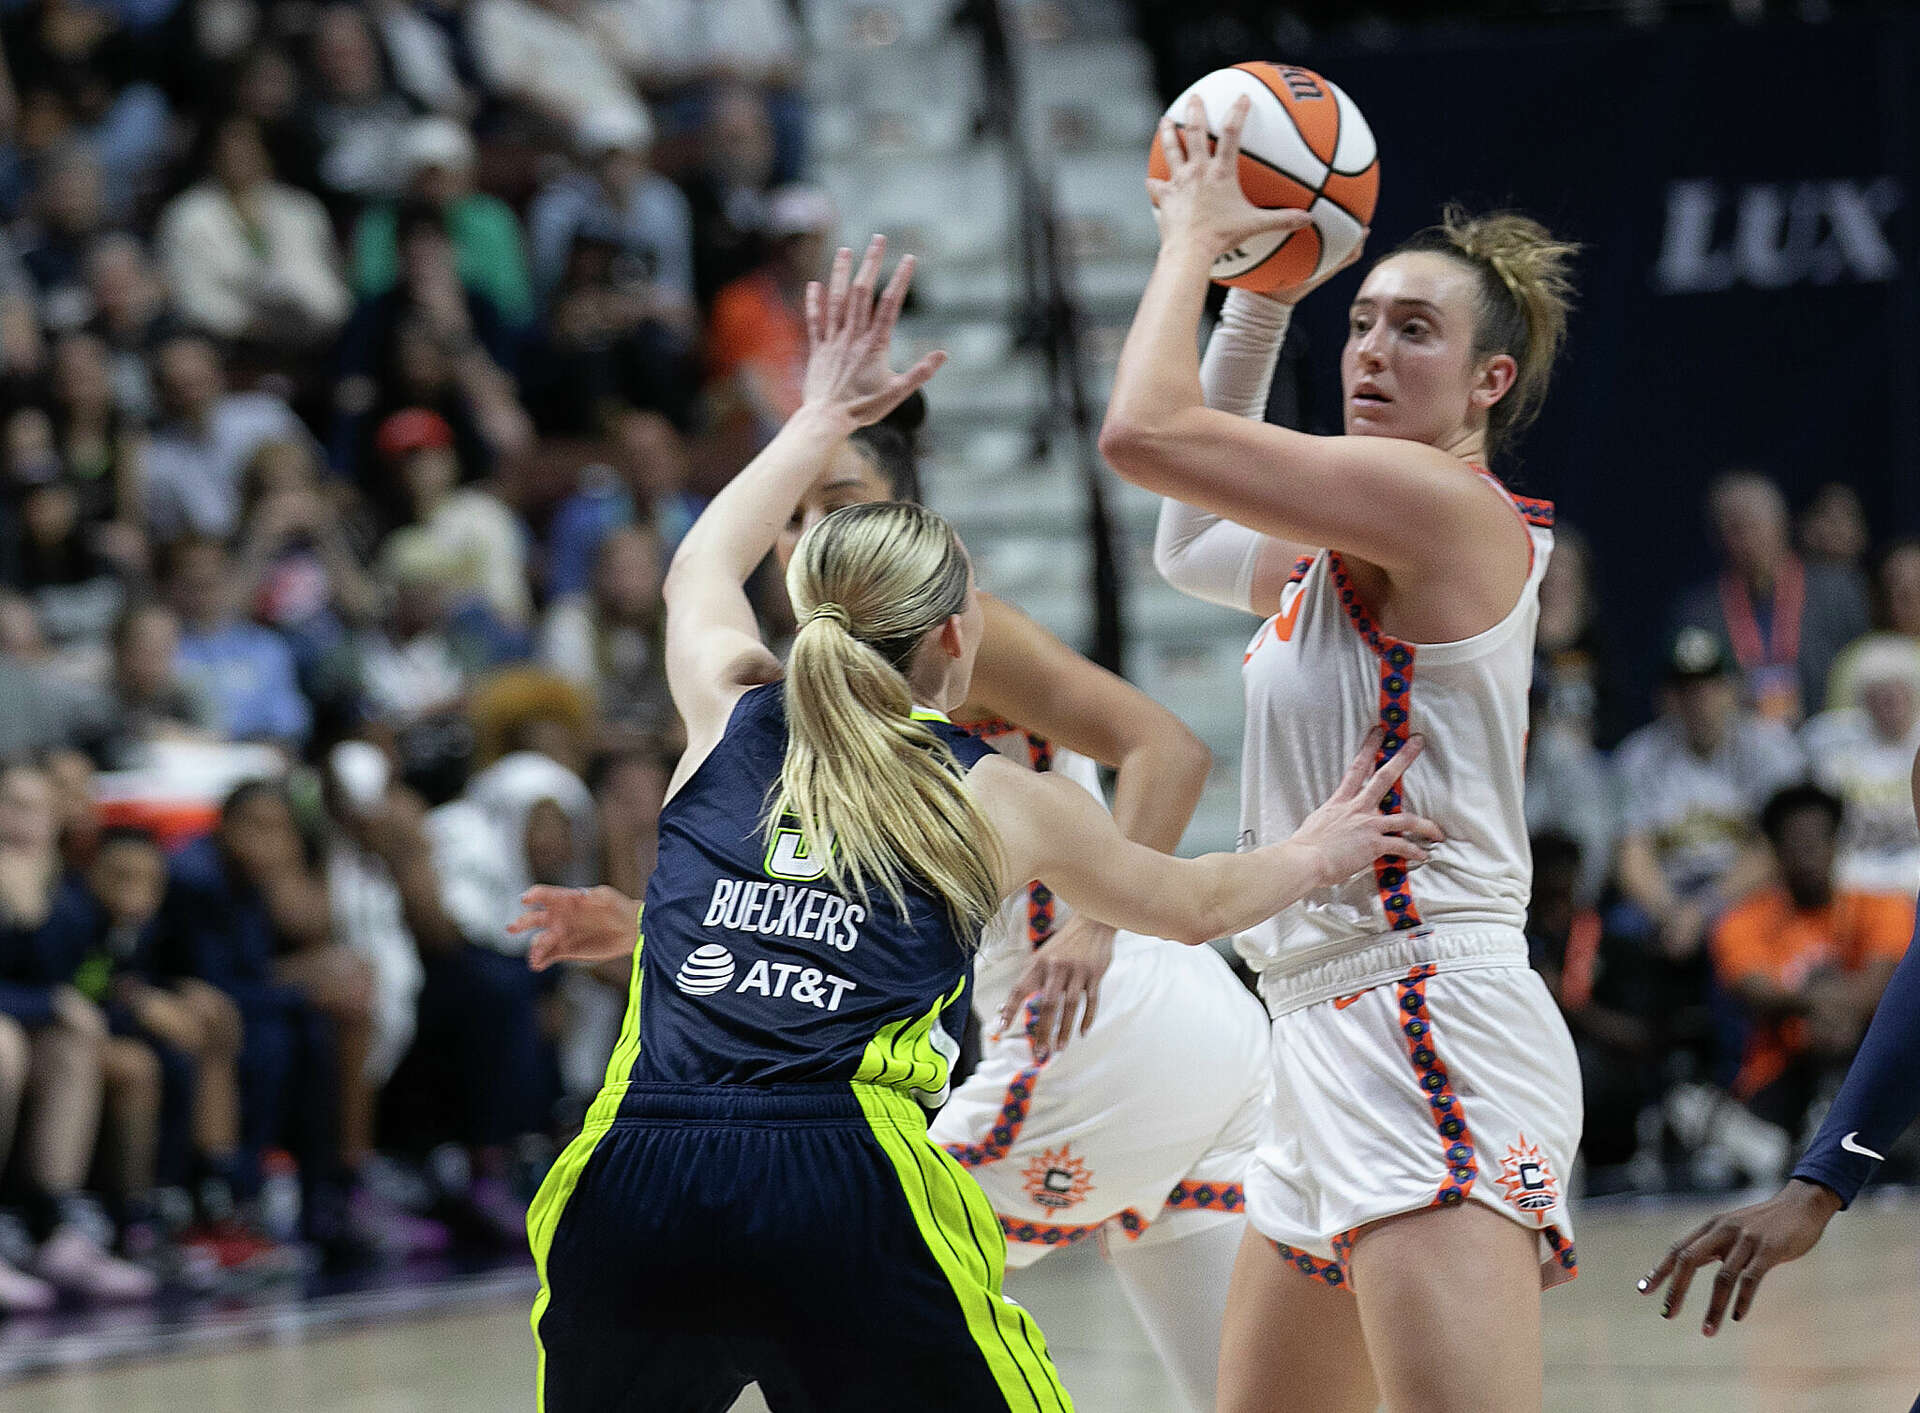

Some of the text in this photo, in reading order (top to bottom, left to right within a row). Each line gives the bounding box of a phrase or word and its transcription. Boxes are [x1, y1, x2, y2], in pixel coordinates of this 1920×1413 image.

[1655, 181, 1900, 292] LUX
[703, 878, 865, 952] BUECKERS
[735, 960, 856, 1011] AT&T
[1044, 1167, 1073, 1193] C
[1520, 1163, 1544, 1190] C
